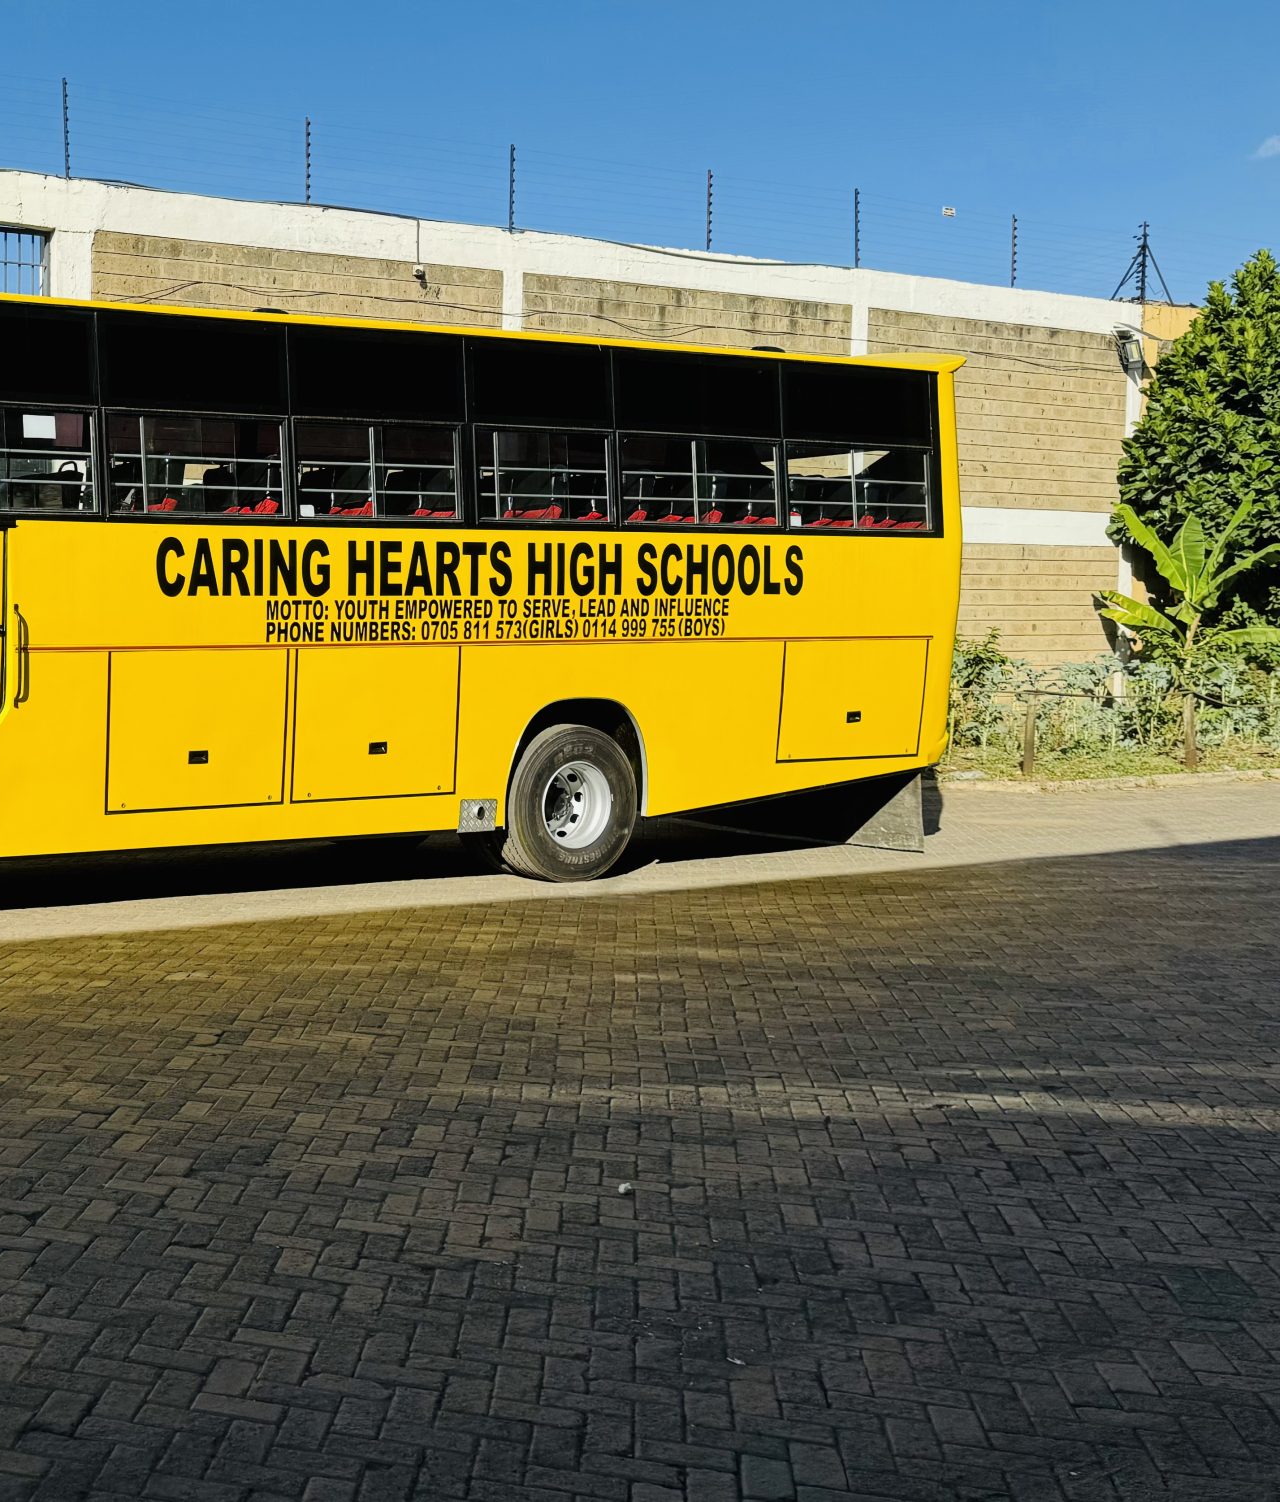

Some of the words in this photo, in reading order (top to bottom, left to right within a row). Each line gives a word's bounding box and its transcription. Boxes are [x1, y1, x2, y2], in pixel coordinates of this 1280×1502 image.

[156, 536, 331, 598] CARING
[347, 540, 513, 597] HEARTS
[527, 542, 623, 597] HIGH
[636, 542, 804, 597] SCHOOLS
[266, 600, 329, 620] MOTTO:
[335, 600, 390, 620] YOUTH
[395, 599, 493, 619] EMPOWERED
[499, 599, 518, 618] TO
[522, 598, 576, 619] SERVE,
[579, 598, 616, 618] LEAD
[620, 598, 650, 617] AND
[654, 598, 729, 617] INFLUENCE
[266, 621, 324, 642] PHONE
[330, 620, 416, 641] NUMBERS:
[421, 620, 459, 640] 0705
[463, 620, 489, 640] 811
[582, 618, 617, 637] 0114
[622, 618, 647, 637] 999
